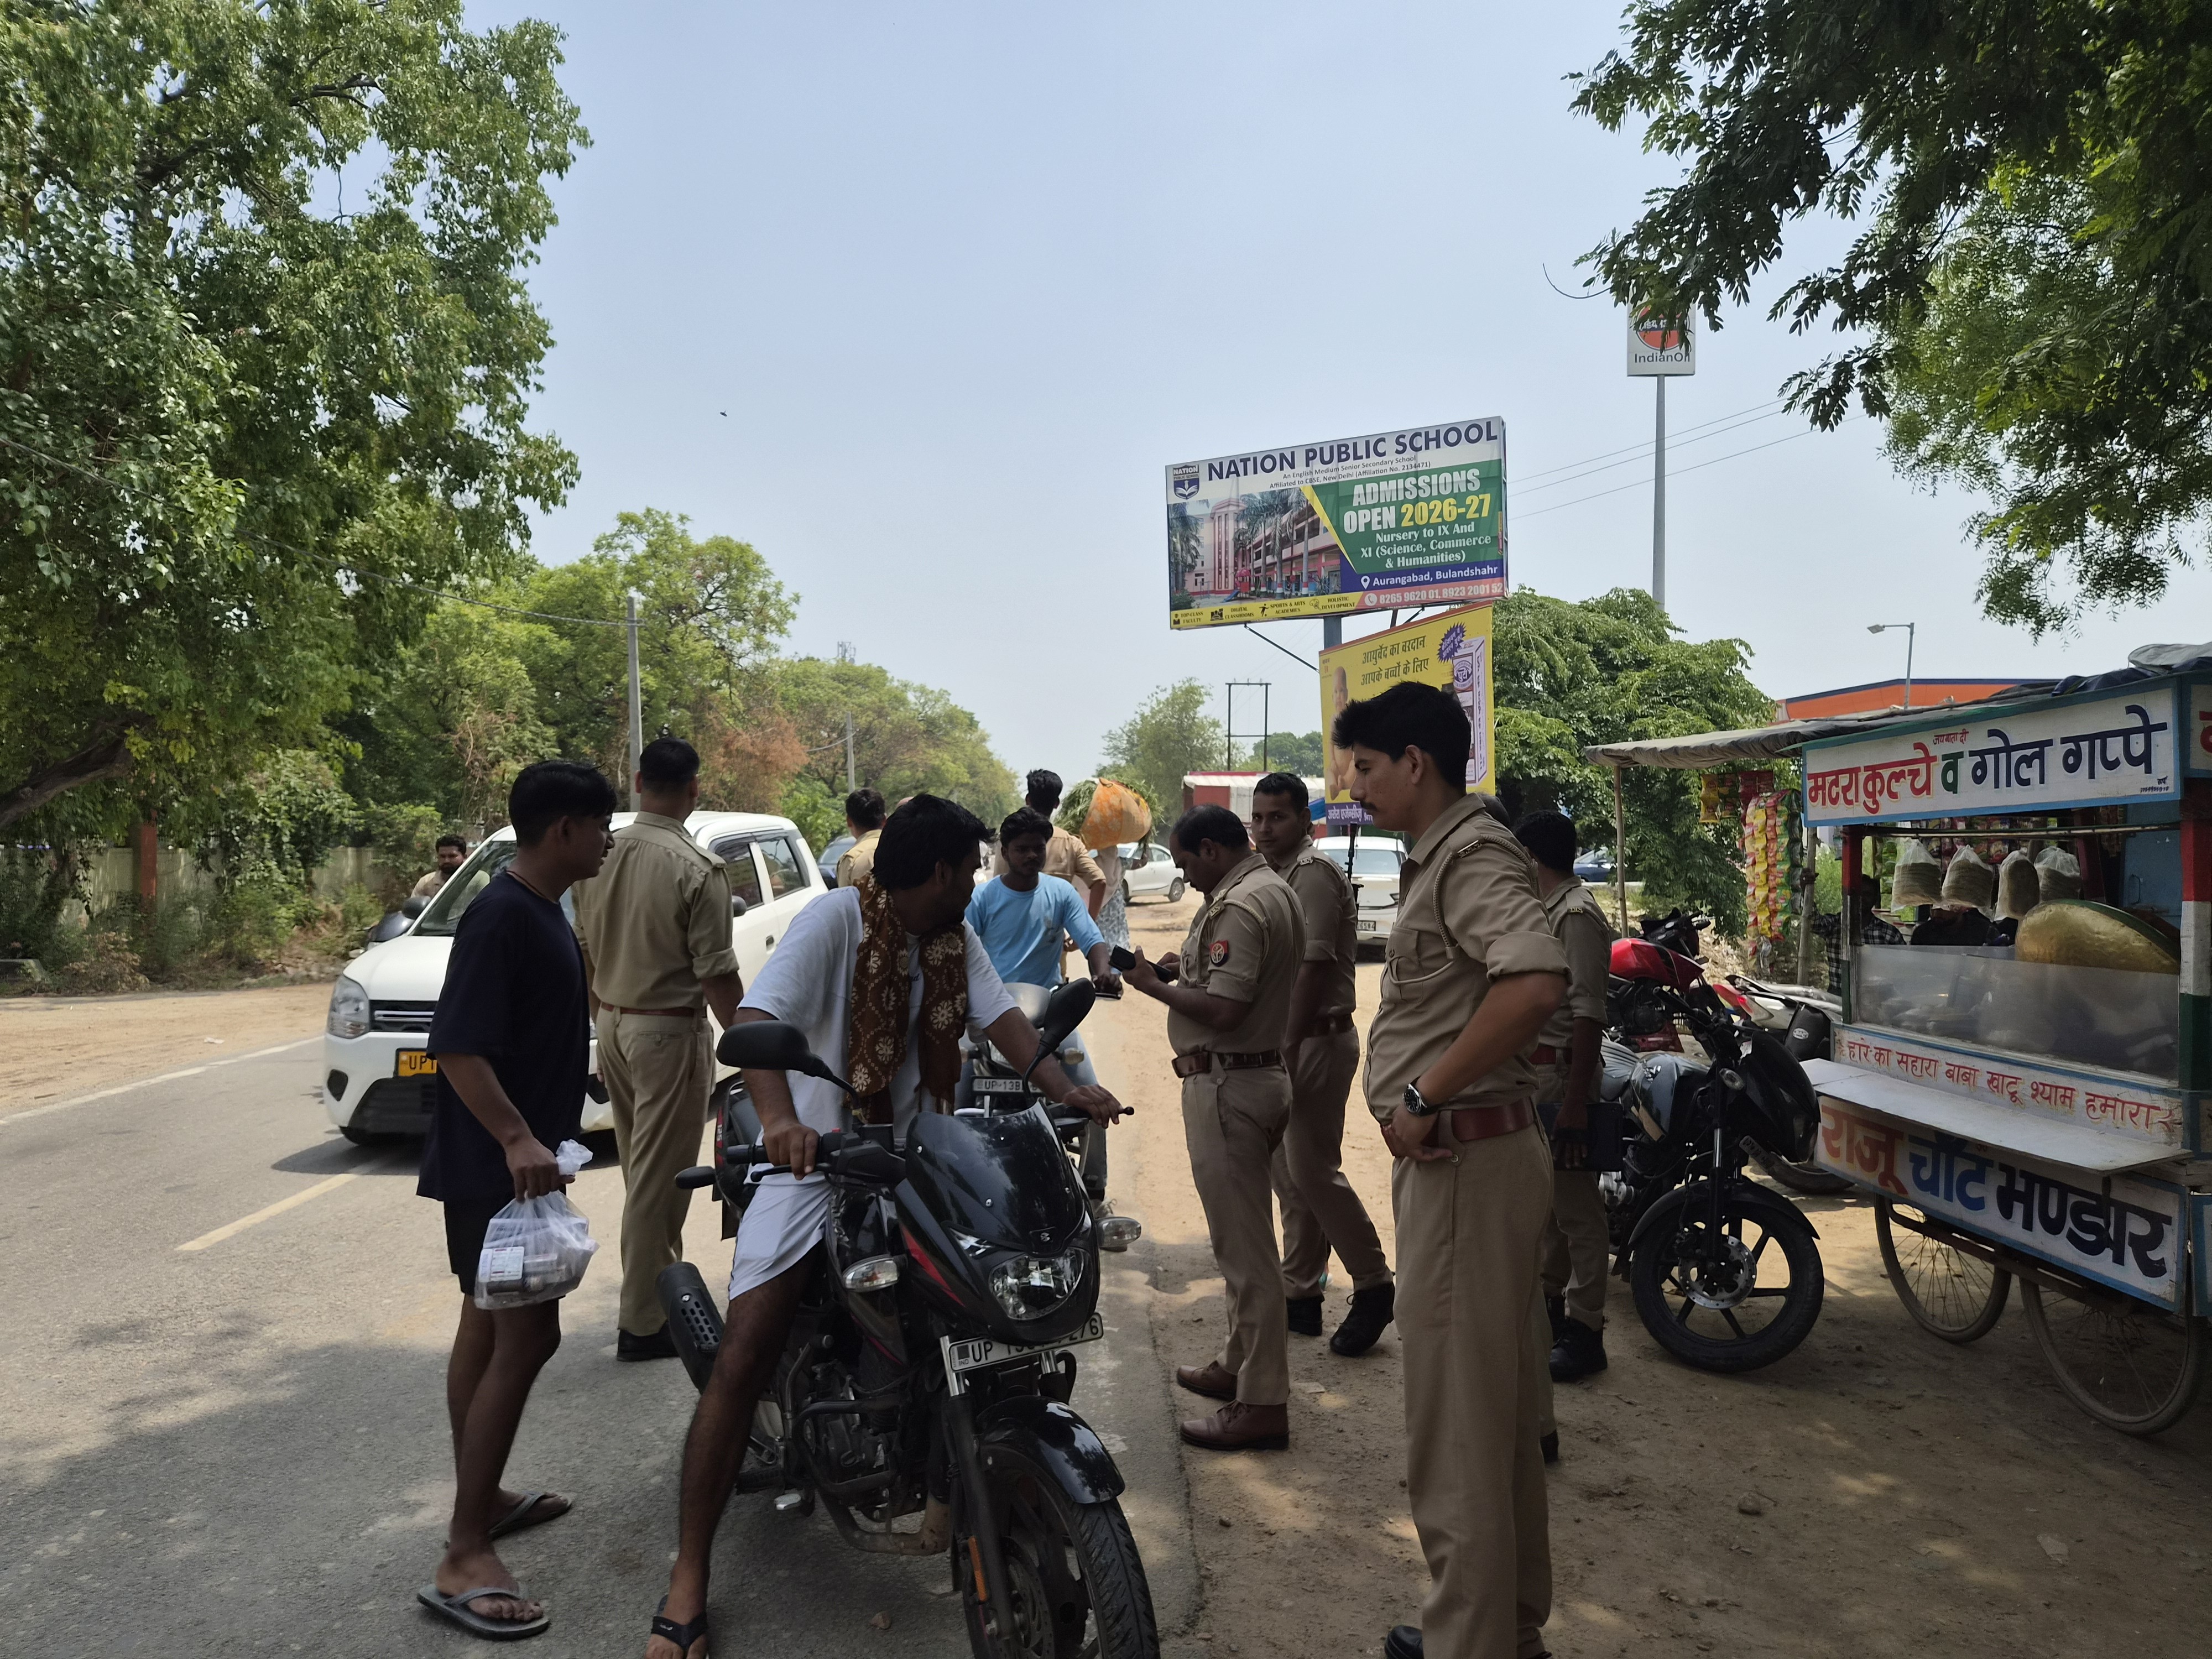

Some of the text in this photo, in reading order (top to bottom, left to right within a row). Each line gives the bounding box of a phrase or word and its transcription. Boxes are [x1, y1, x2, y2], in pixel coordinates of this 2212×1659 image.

[1208, 421, 1498, 481] NATION PUBLIC SCHOOL
[1173, 465, 1198, 475] NATION
[1270, 481, 1296, 489] Affiliated
[1355, 467, 1387, 479] (Affiliation
[1402, 461, 1431, 471] 2134471)
[1292, 471, 1313, 479] English
[1314, 466, 1339, 475] Medium
[1361, 458, 1394, 468] Secondary
[1395, 455, 1416, 463] School
[1353, 468, 1480, 507] ADMISSIONS
[1344, 493, 1490, 534] OPEN 2026-27
[1376, 521, 1475, 544] Nursery to IX And
[1361, 535, 1491, 559] XI (Science, Commerce
[1385, 550, 1466, 568] & Humanities)
[1373, 565, 1498, 586] Aurangabad, Bulandshahr
[1380, 593, 1402, 604] 8265
[1442, 587, 1465, 598] 8923
[1468, 585, 1490, 596] 2001
[1491, 583, 1503, 593] 52
[1390, 643, 1400, 656] का
[1402, 635, 1426, 653] वरदान
[1361, 657, 1430, 686] आपके बच्चों के लिए
[1959, 728, 1969, 744] दी
[1941, 751, 1964, 794] व
[1969, 729, 2053, 789] गोल
[2060, 705, 2168, 779] गप्पे
[1848, 1038, 2161, 1129] हारे का सहारा बाबा खाटू श्याम हमारा
[1821, 1105, 1908, 1195] राजू
[1996, 1160, 2172, 1279] भण्डार
[972, 1341, 993, 1363] UP
